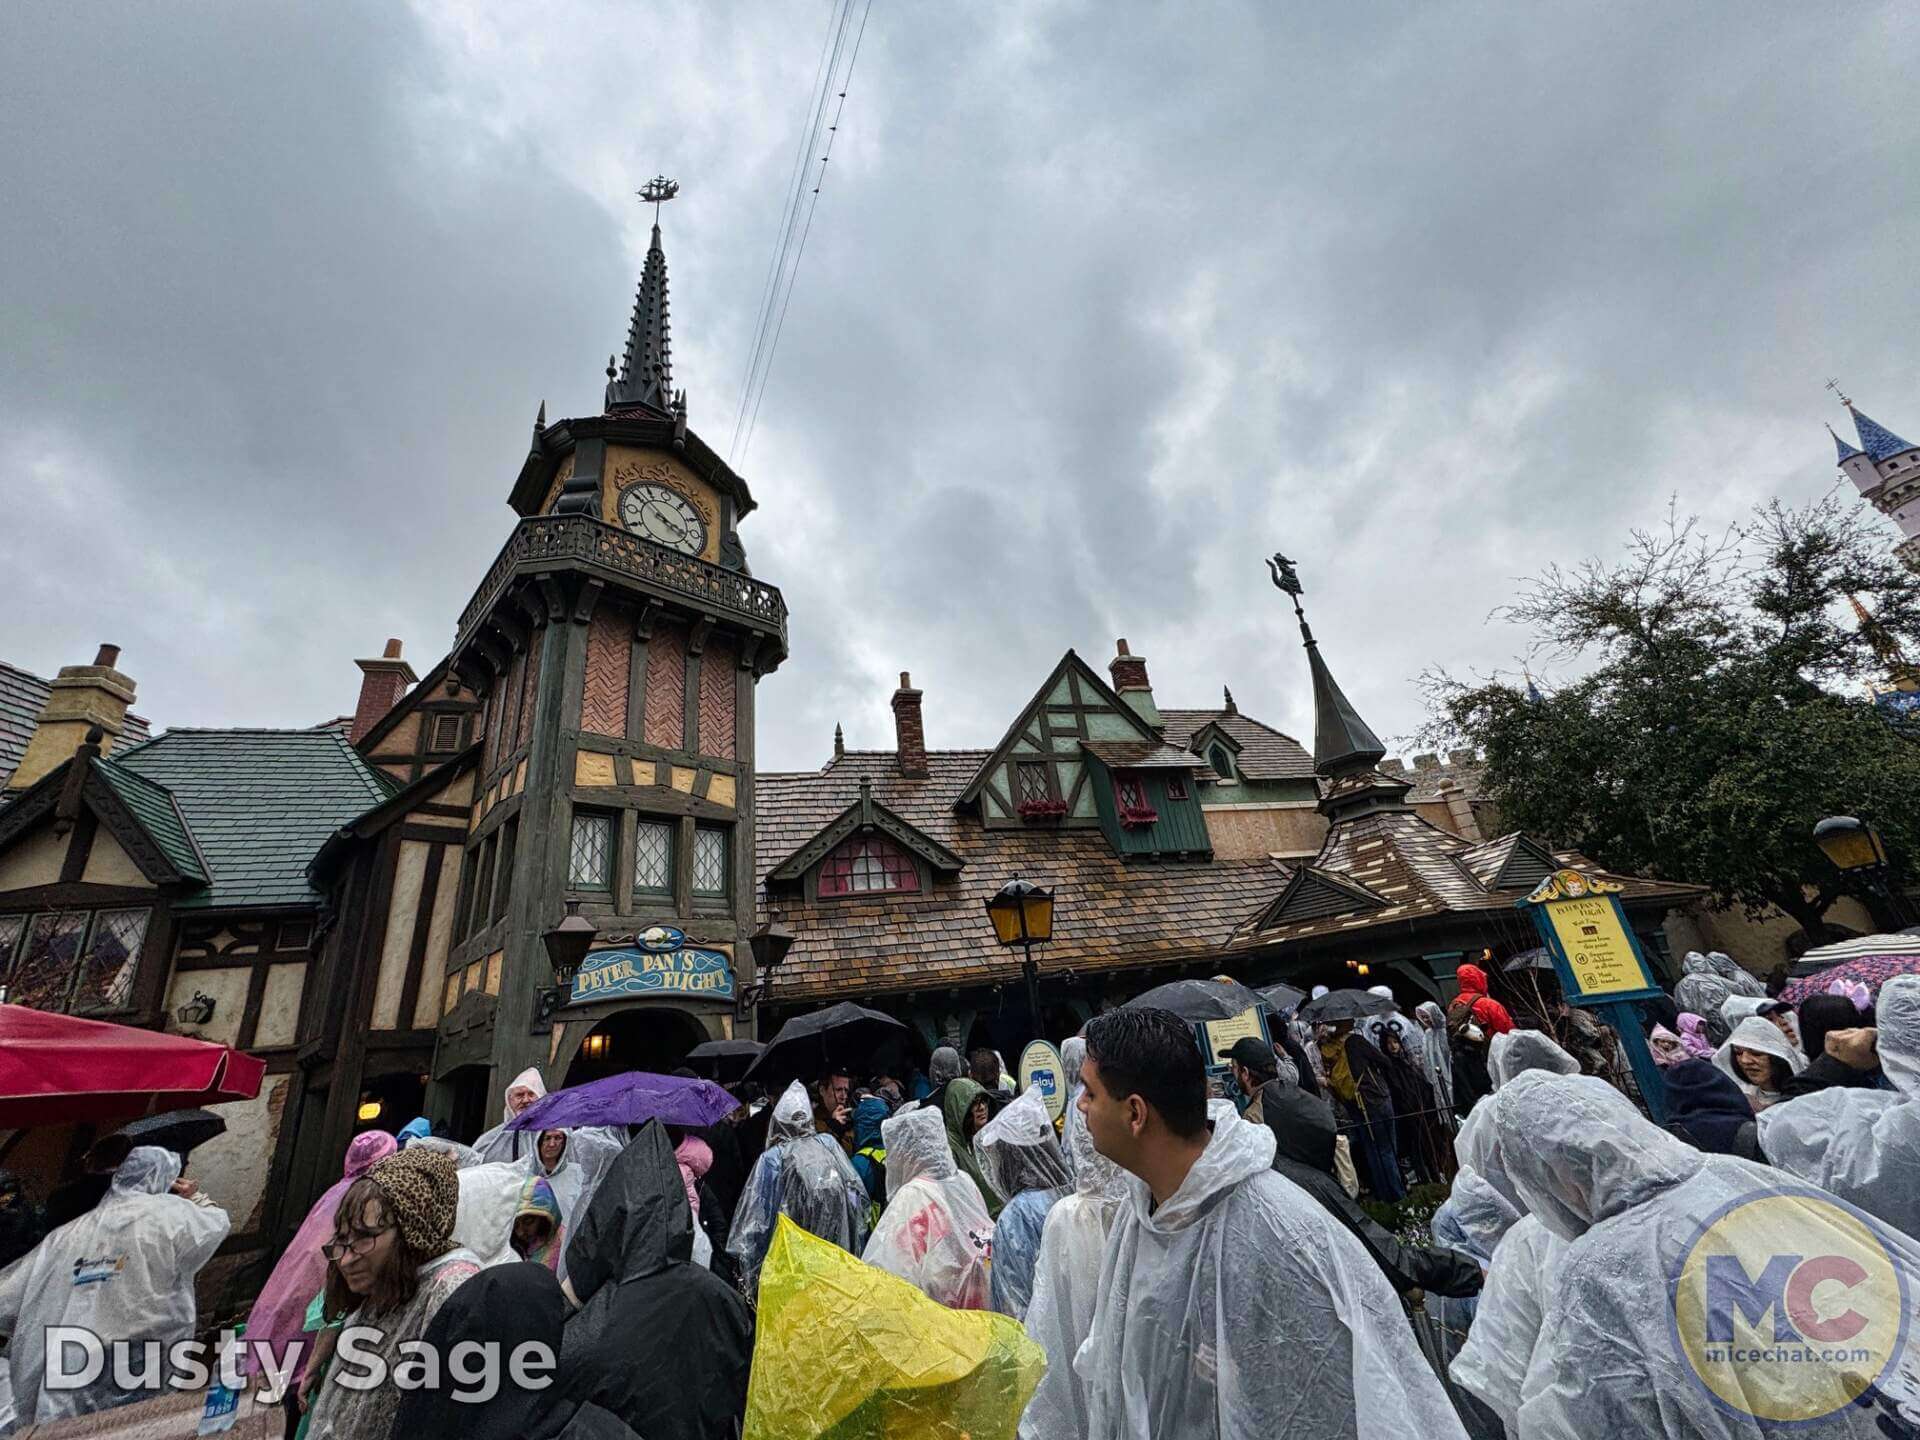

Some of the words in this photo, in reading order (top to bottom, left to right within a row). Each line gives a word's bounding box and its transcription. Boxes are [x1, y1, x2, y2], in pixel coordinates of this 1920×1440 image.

[577, 960, 641, 992] PETER
[642, 951, 696, 973] PAN'S
[663, 969, 726, 991] FLIGHT
